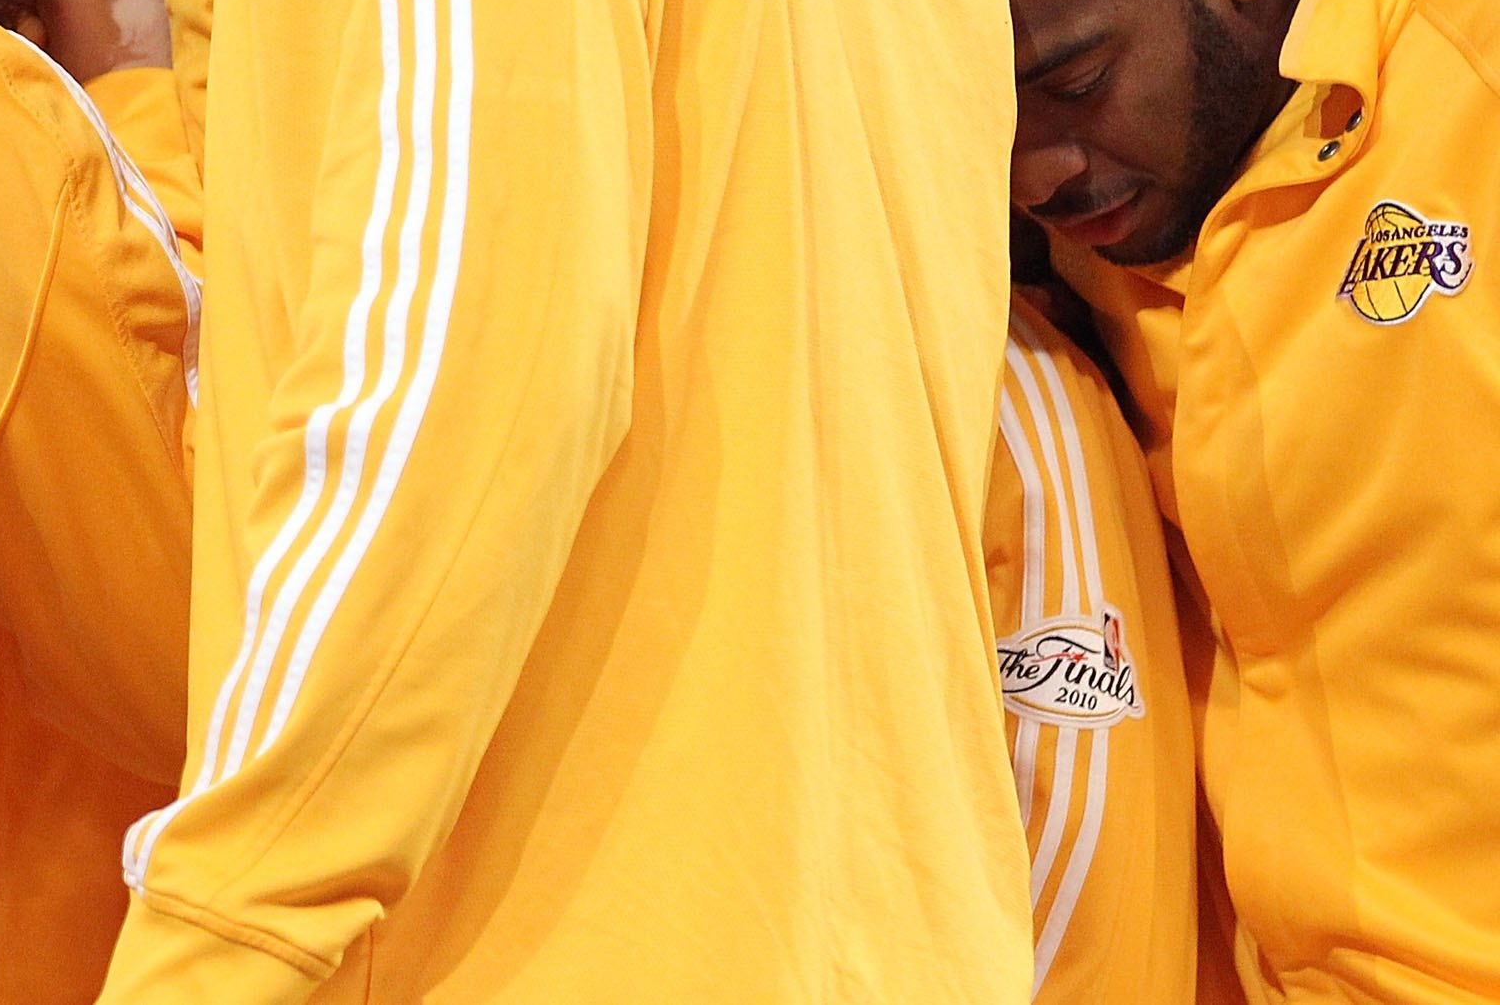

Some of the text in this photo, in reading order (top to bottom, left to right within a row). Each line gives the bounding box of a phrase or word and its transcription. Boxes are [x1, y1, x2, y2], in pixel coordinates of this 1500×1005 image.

[1371, 224, 1469, 244] LOS ANGELES
[1339, 237, 1473, 294] LAKERS
[997, 635, 1140, 709] The Finals
[1054, 687, 1098, 711] 2010
